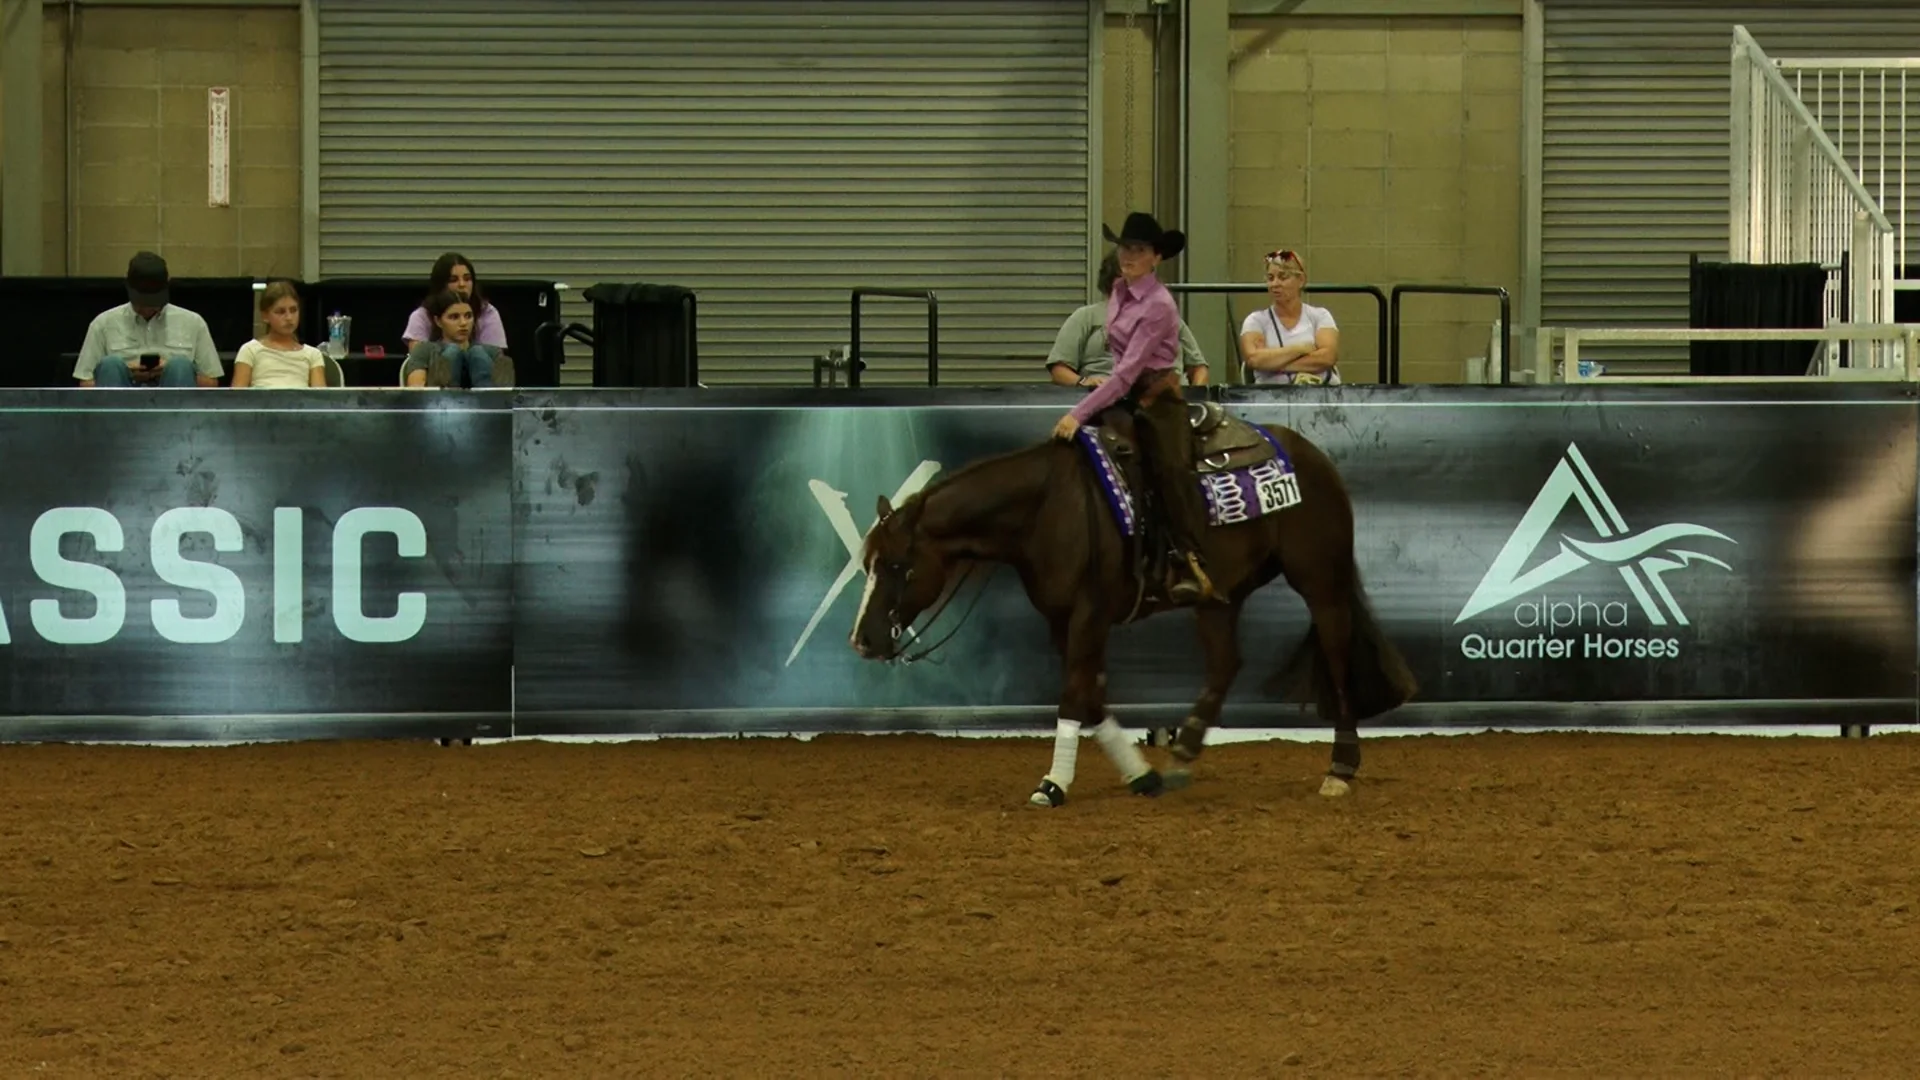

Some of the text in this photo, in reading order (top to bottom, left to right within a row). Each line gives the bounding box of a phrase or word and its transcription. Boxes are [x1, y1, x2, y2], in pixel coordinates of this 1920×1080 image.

[1262, 477, 1298, 509] 3571
[0, 506, 427, 644] SSIC
[1514, 594, 1628, 635] alpha
[1460, 633, 1680, 659] Quarter Horses
